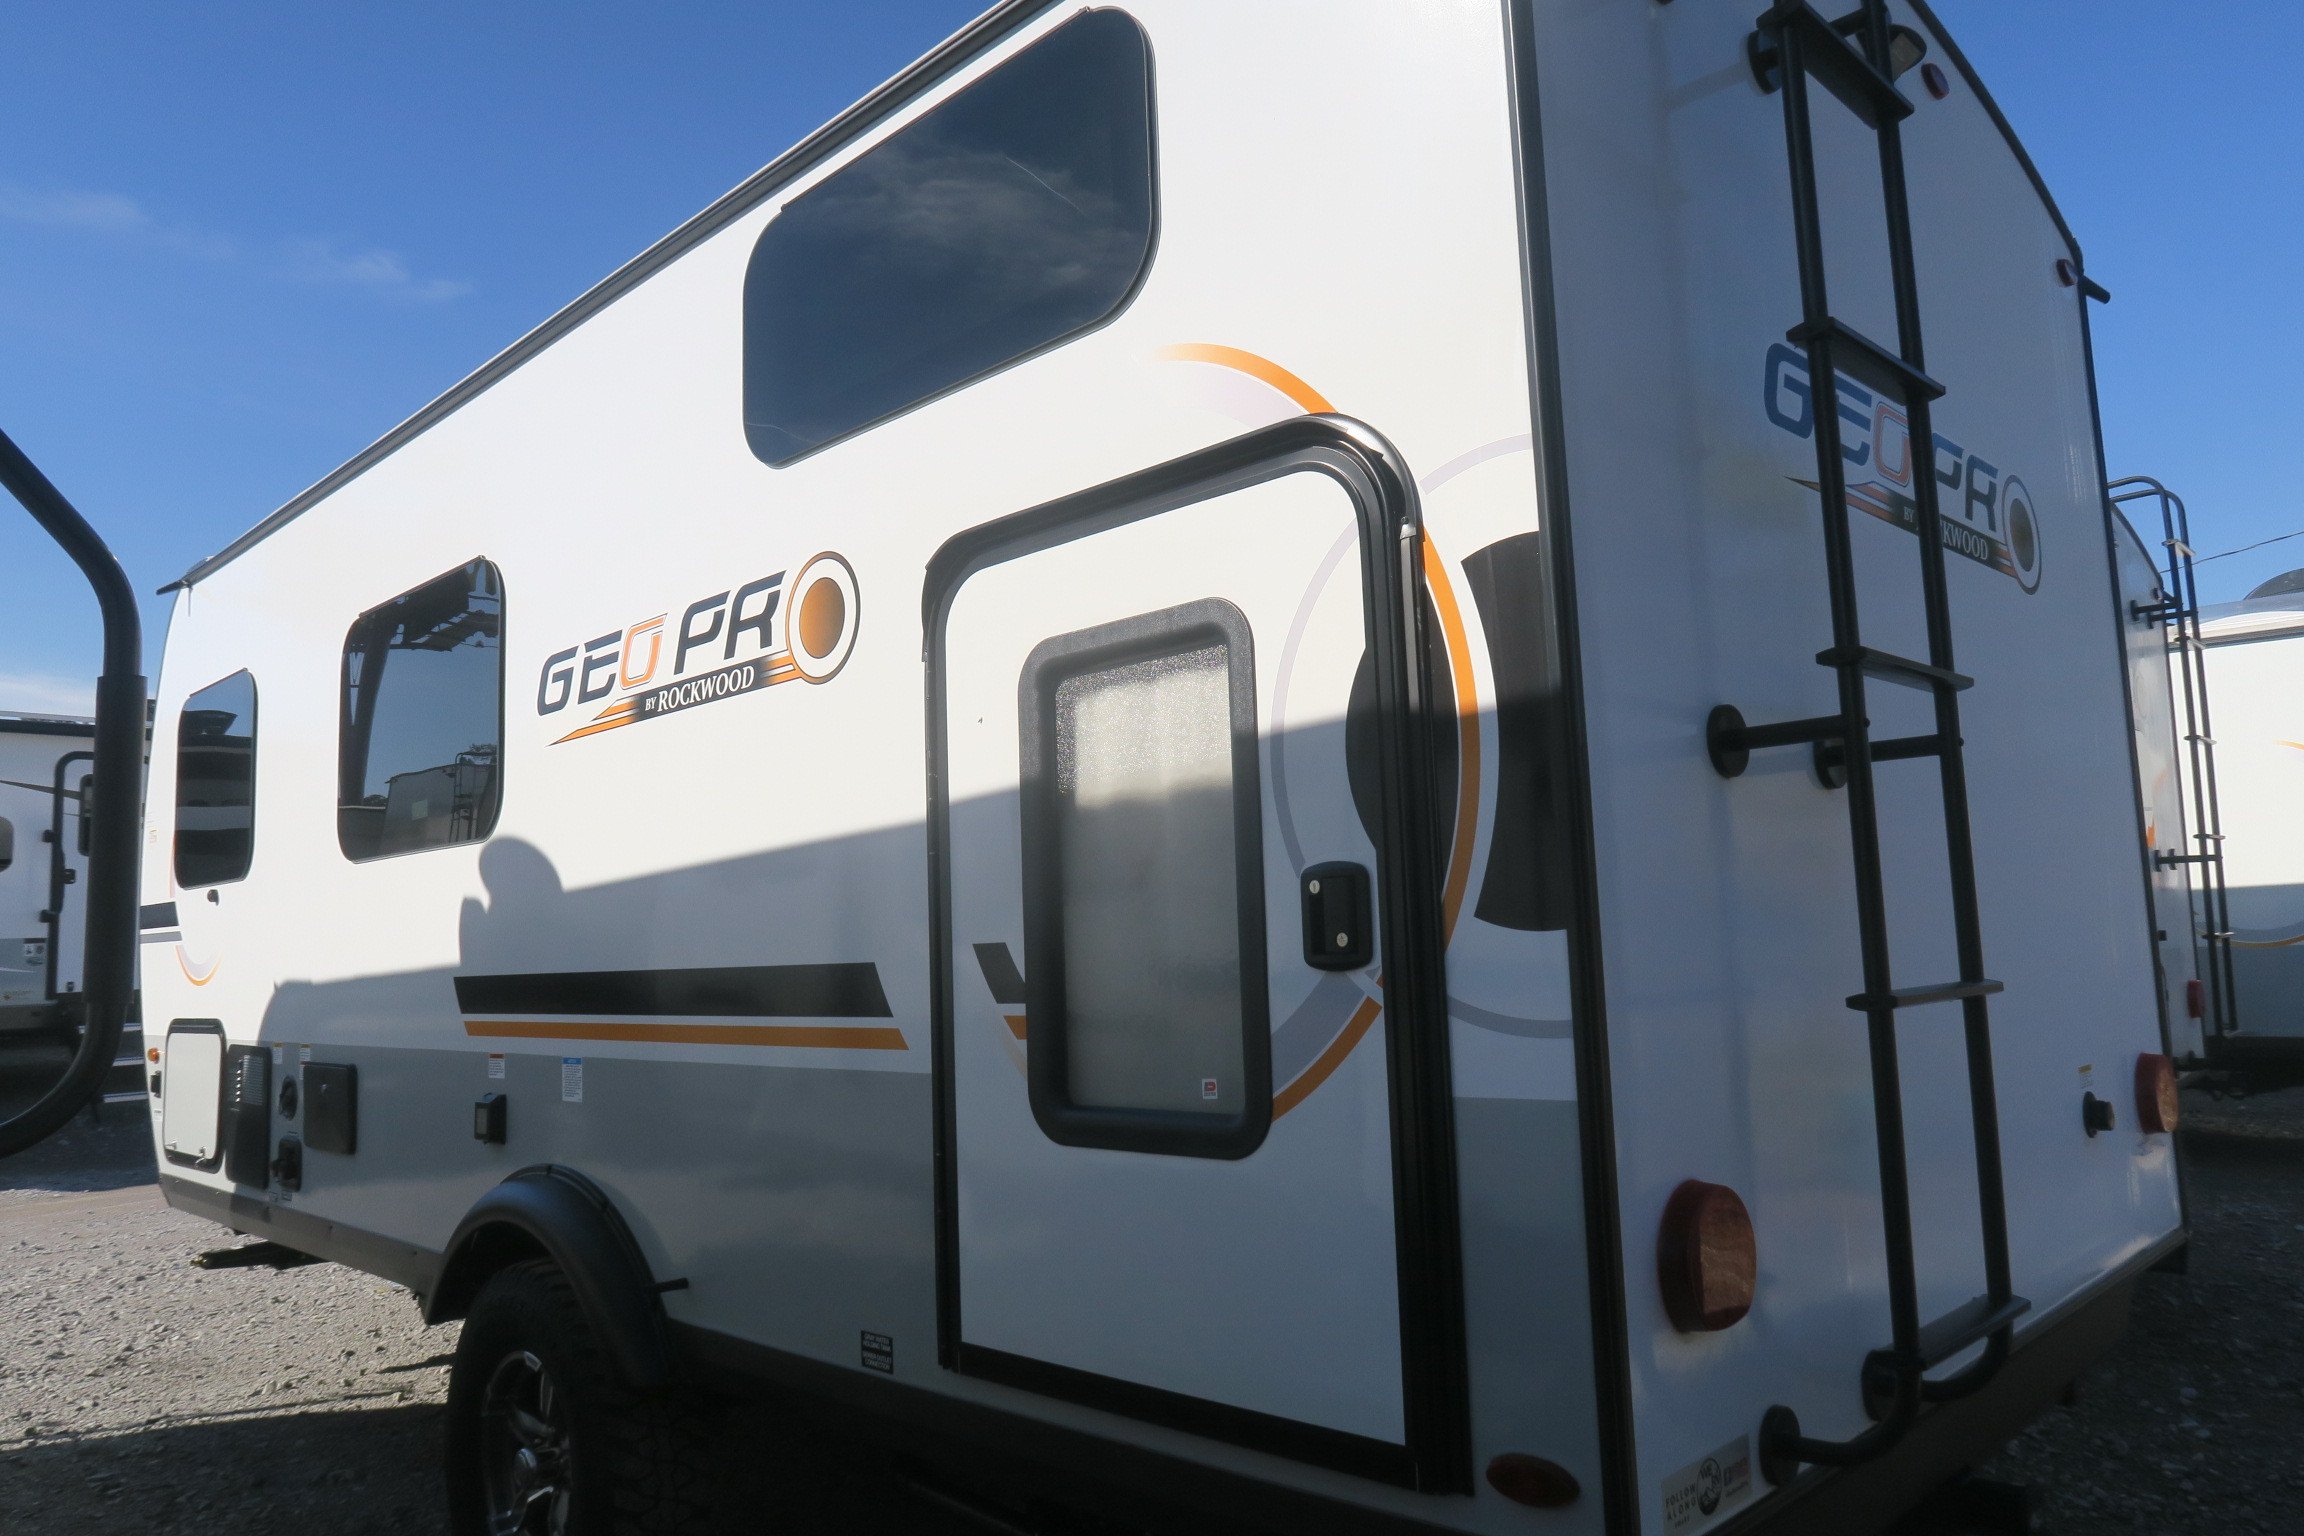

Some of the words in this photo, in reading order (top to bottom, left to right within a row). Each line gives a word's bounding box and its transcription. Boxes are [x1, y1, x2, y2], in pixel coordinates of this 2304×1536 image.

[1903, 506, 1914, 523] BY
[537, 612, 668, 717] GEO
[673, 550, 861, 686] PRO
[645, 696, 657, 711] BY
[657, 664, 755, 713] ROCKWOOD
